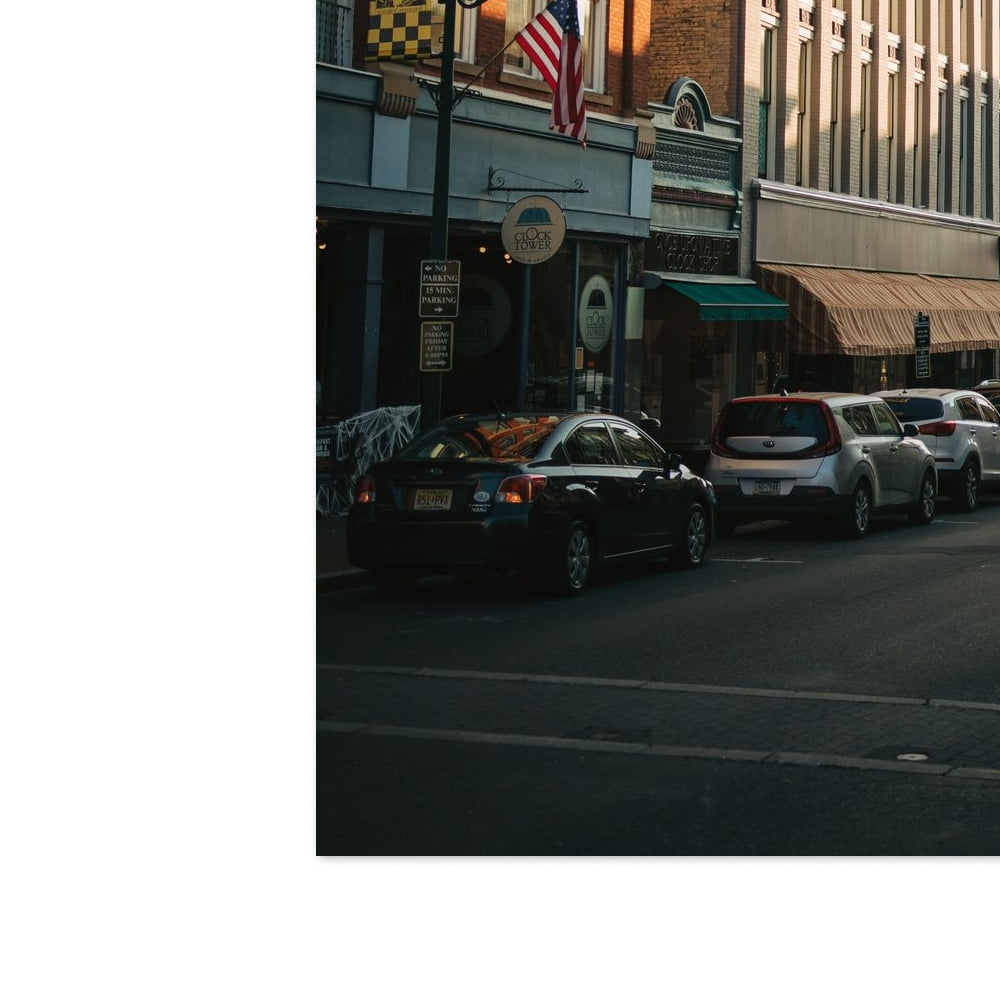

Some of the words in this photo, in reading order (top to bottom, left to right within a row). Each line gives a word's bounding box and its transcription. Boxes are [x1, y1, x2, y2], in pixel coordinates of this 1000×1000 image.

[514, 227, 552, 242] CLOCK
[514, 241, 552, 250] TOWER
[422, 274, 458, 282] PARKING
